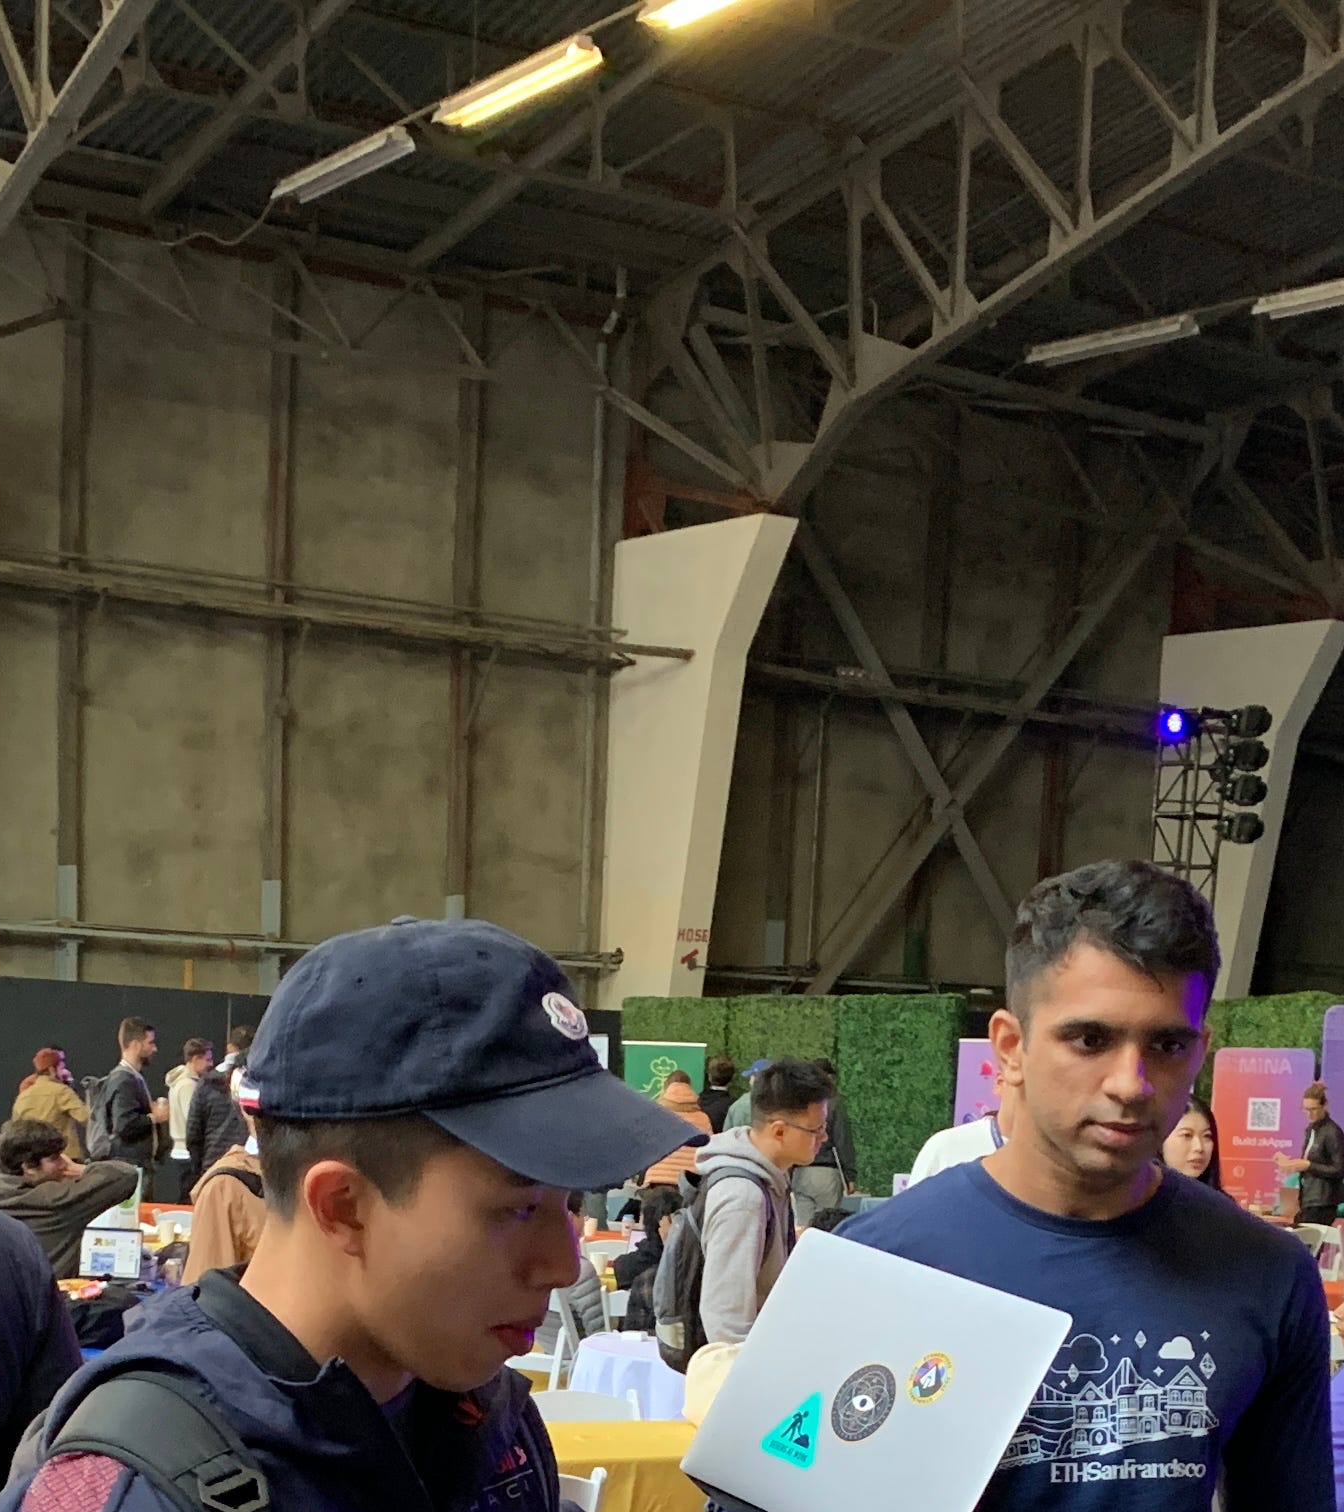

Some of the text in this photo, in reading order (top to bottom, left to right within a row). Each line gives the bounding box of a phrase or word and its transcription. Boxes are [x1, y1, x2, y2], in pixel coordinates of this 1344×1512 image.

[677, 929, 708, 943] HOSE
[1239, 1058, 1292, 1074] MINA
[1233, 1136, 1256, 1146] Build
[1050, 1459, 1206, 1483] ETHSanFrancisco
